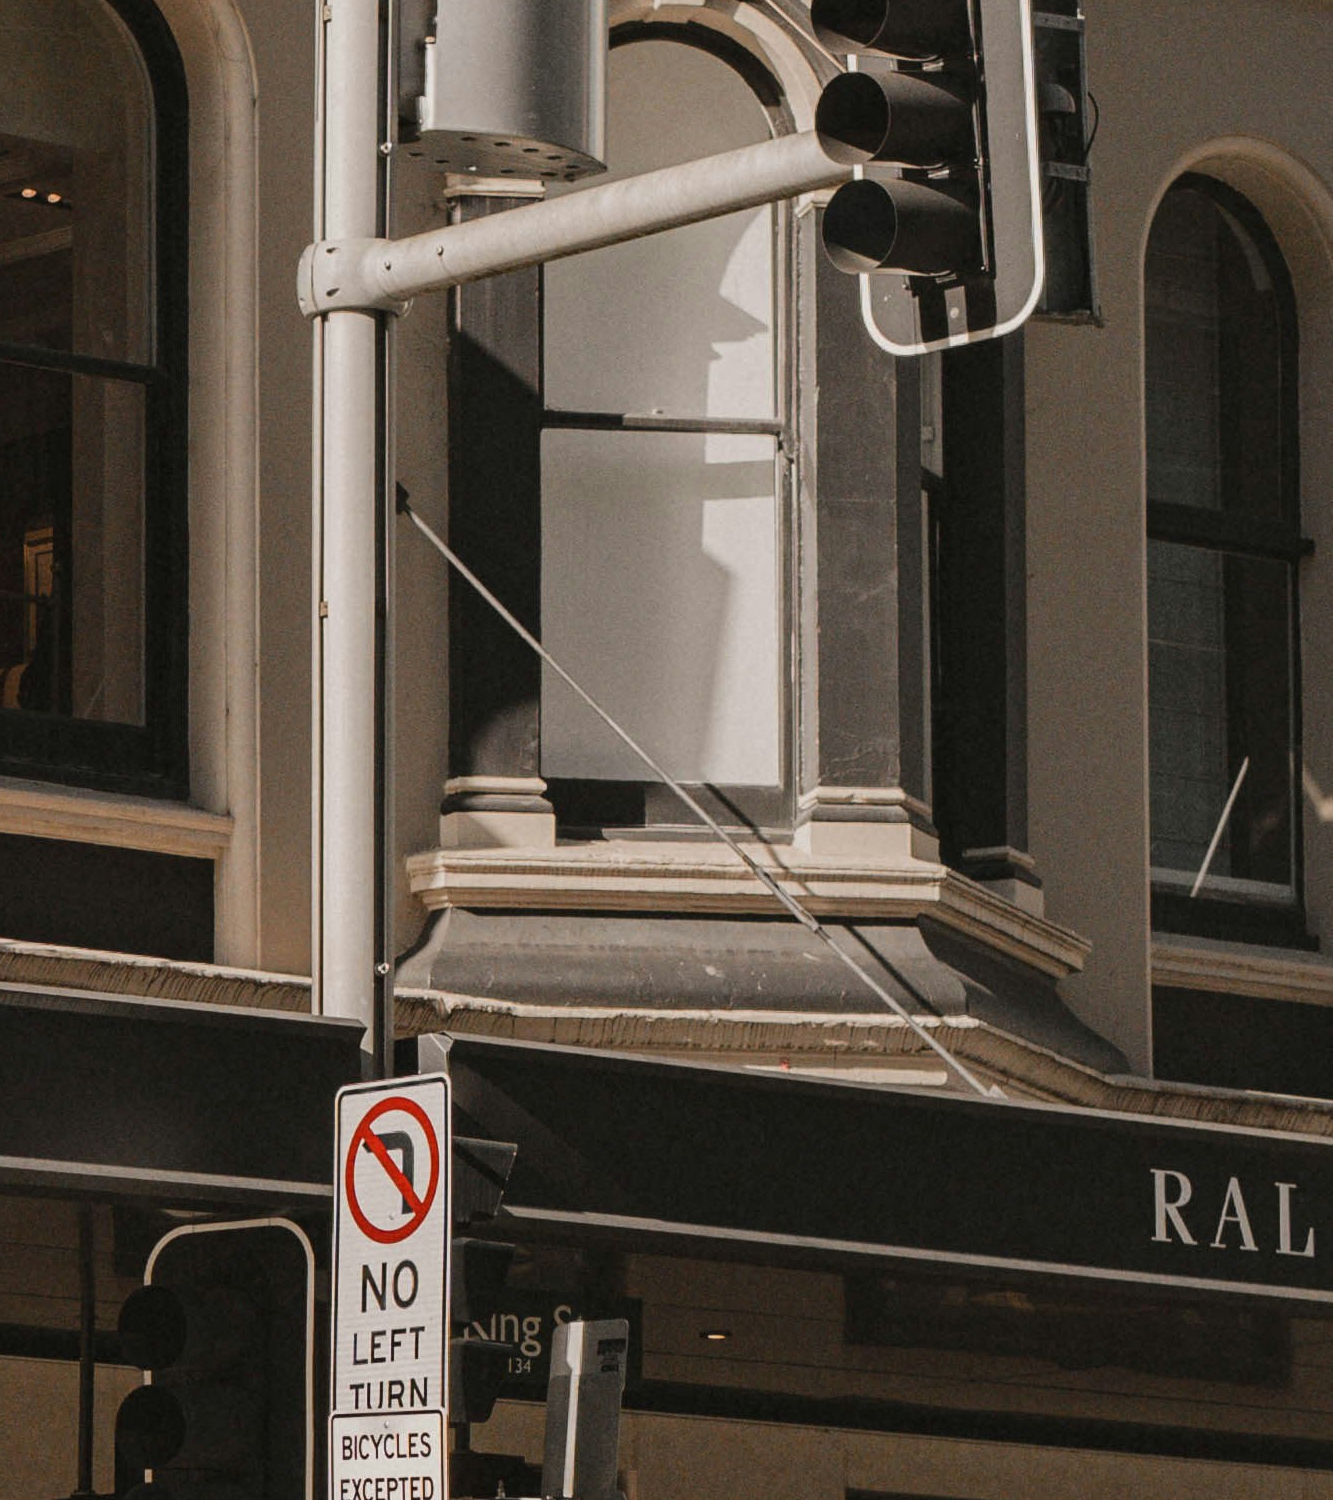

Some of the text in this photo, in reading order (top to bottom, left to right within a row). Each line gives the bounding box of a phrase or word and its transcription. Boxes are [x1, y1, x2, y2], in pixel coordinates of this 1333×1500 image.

[1150, 1168, 1315, 1258] RAL
[361, 1260, 419, 1313] NO
[352, 1326, 426, 1366] LEFT
[508, 1357, 532, 1374] 134
[349, 1377, 428, 1409] TURN
[341, 1432, 432, 1461] BICYCLES
